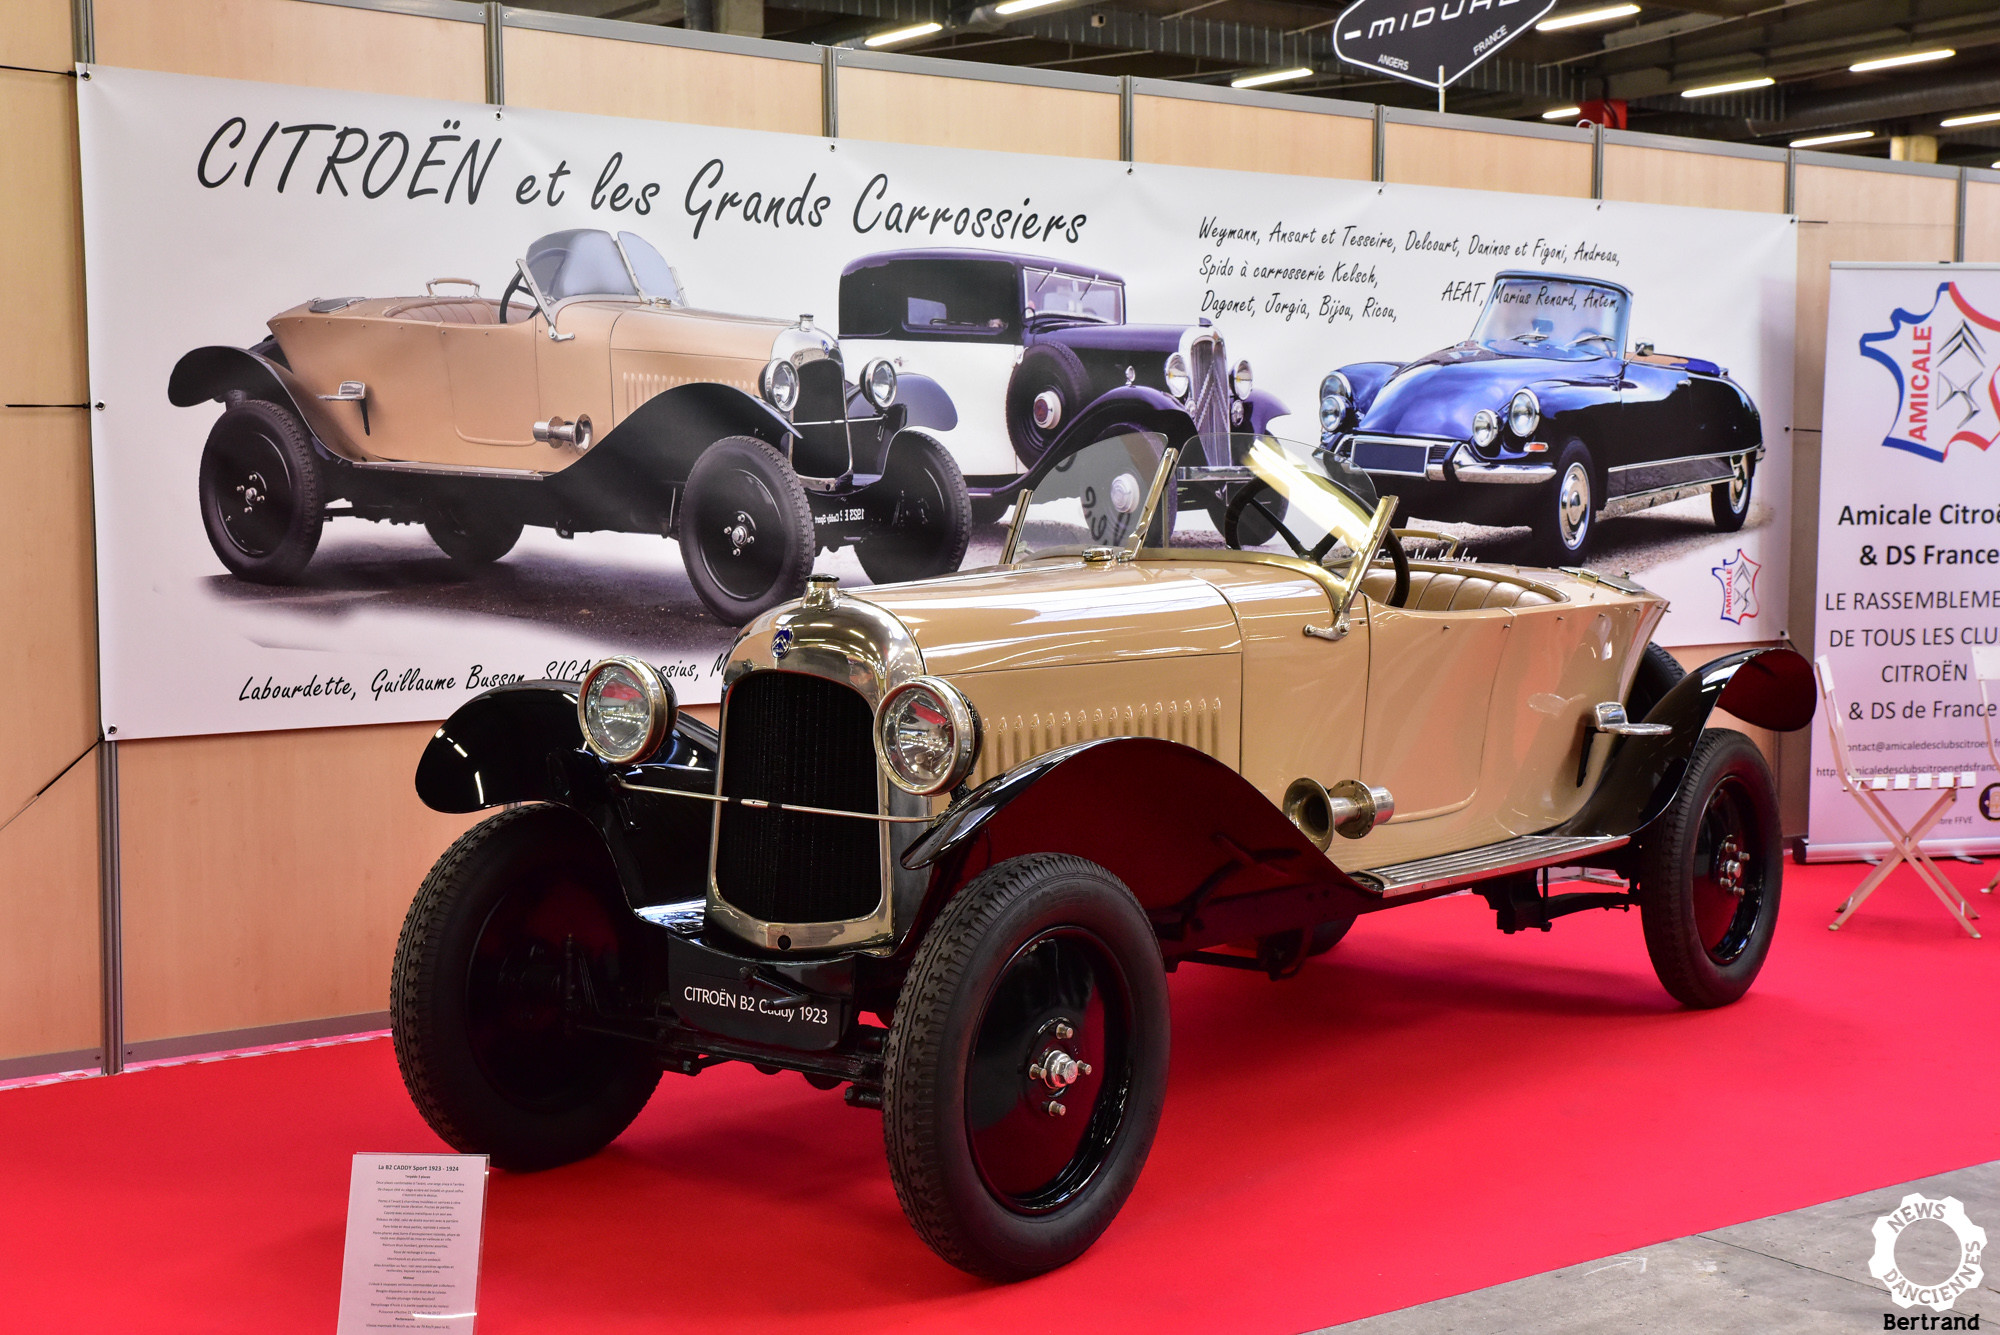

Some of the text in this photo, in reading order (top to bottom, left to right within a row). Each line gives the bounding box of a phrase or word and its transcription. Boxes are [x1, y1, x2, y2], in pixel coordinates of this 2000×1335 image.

[1368, 0, 1521, 39] MIDUA
[1473, 25, 1508, 56] FRANCE
[1377, 54, 1409, 71] ANGERS
[197, 117, 1087, 244] CITROËN et les Grands Carrossiers
[1198, 216, 1621, 267] Weymann, Ansart et Tesseire, Delcourt, Daninos et Figoni, Andreau,
[1199, 254, 1379, 289] Spido à carrosserie Kelsch,
[1200, 290, 1398, 324] Dagonet, Jorgia, Bijou, Ricou,
[1441, 281, 1619, 312] AEAT, Marius Renard, Antem,
[1908, 326, 1932, 441] AMICALE
[1838, 504, 1931, 525] Amicale
[1859, 545, 1999, 566] & DS France
[1725, 568, 1733, 615] AMICALE
[1825, 593, 1846, 610] LE
[1830, 629, 1855, 647] DE
[1862, 628, 1916, 646] TOUS
[1923, 627, 1955, 645] LES
[239, 677, 357, 703] Labourdette,
[371, 668, 456, 703] Guillaume
[1881, 660, 1967, 682] CITROËN
[1848, 700, 1997, 720] & DS de France
[684, 986, 736, 1009] CITROËN
[740, 995, 755, 1012] B2
[800, 1006, 828, 1025] 1923
